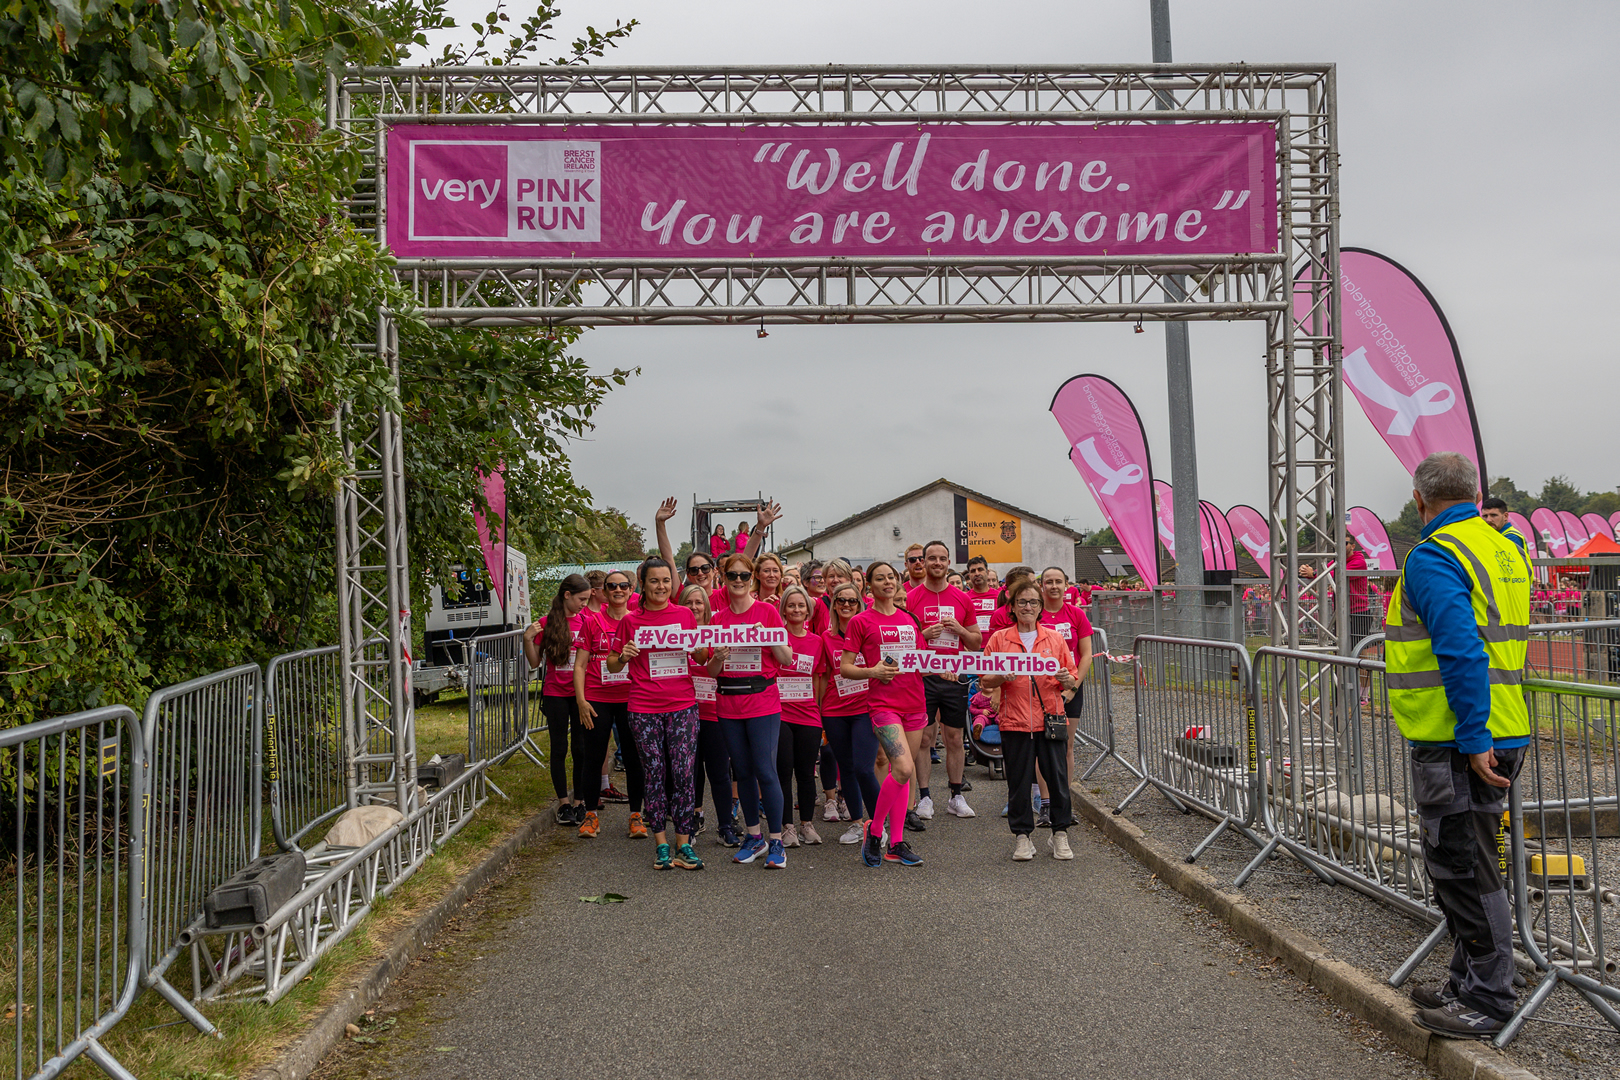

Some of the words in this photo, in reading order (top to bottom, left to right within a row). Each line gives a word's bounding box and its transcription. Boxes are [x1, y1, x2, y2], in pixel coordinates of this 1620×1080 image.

[950, 149, 1130, 192] done.
[420, 178, 501, 210] very
[517, 178, 595, 203] PINK
[517, 206, 585, 230] RUN
[641, 199, 763, 245] You
[789, 211, 895, 244] are
[960, 520, 997, 529] Kilkenny
[960, 529, 979, 538] City
[960, 538, 996, 546] Harriers
[638, 628, 785, 648] #VeryPinkRun
[902, 653, 1057, 673] #VeryPinkTribe
